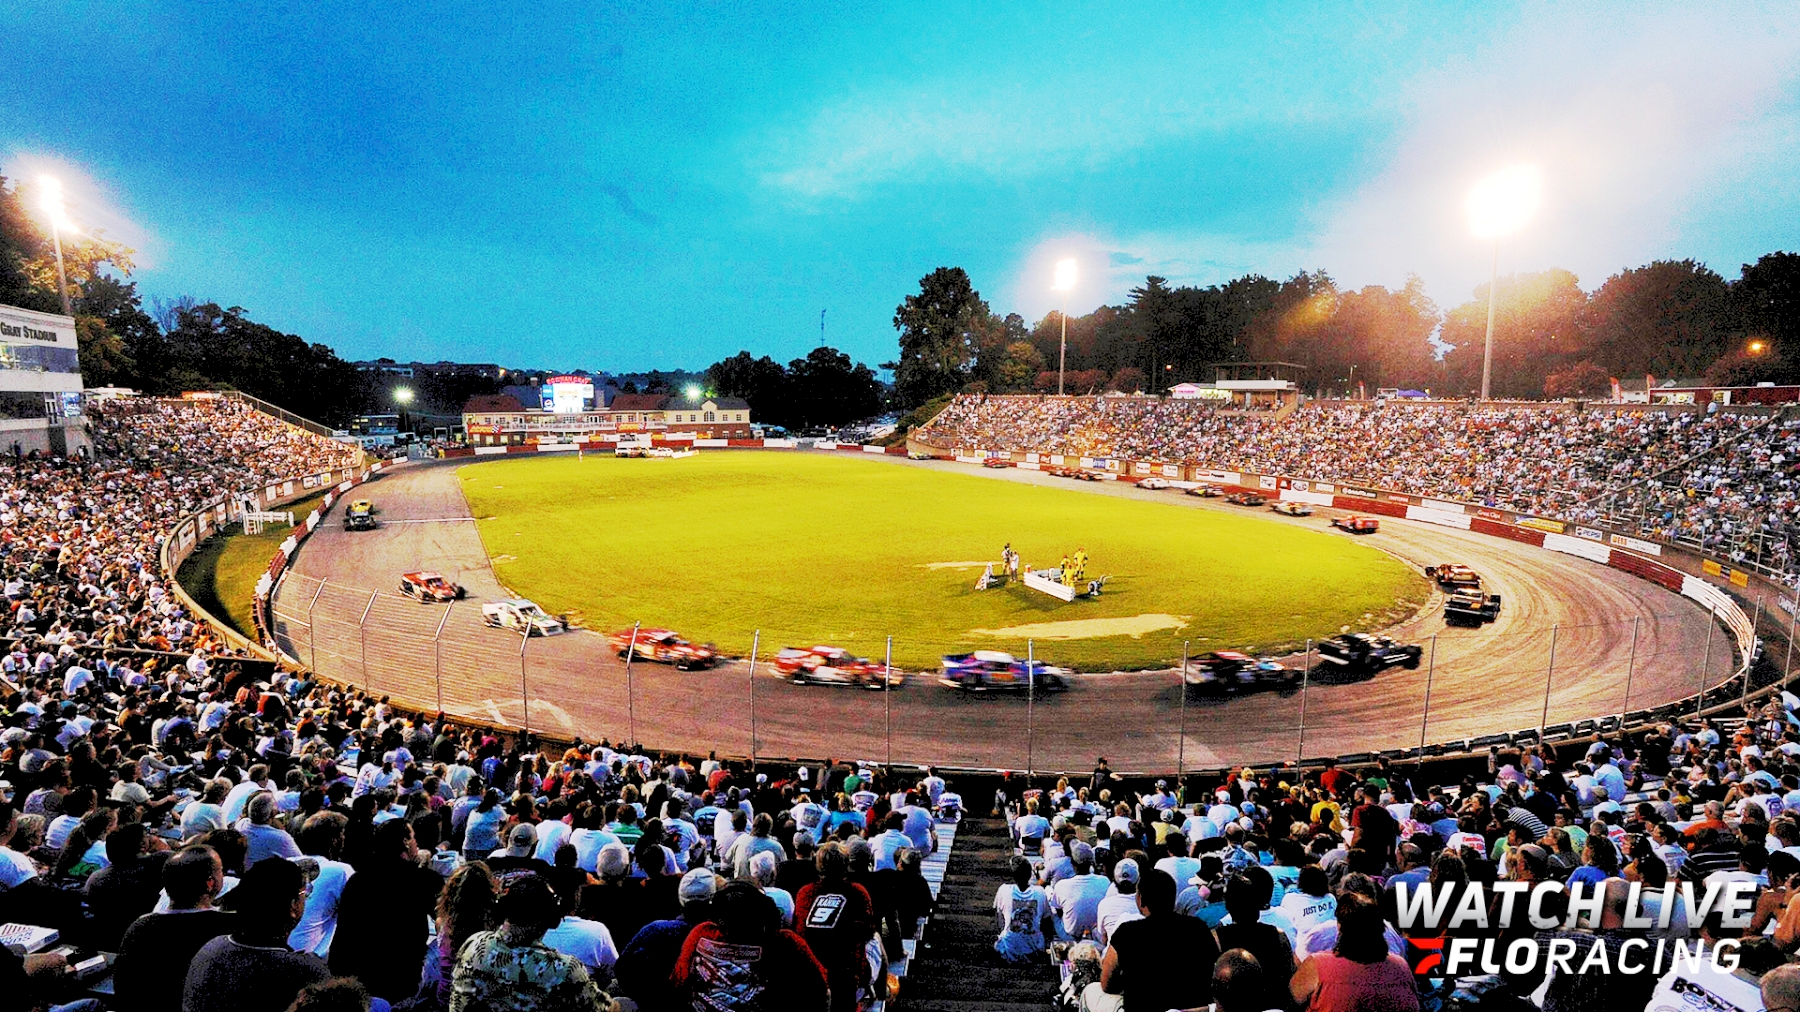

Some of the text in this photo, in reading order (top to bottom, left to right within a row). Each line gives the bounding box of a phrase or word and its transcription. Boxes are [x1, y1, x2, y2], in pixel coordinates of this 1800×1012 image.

[811, 907, 835, 922] 9
[1303, 905, 1317, 917] JUST
[1317, 902, 1328, 912] DO
